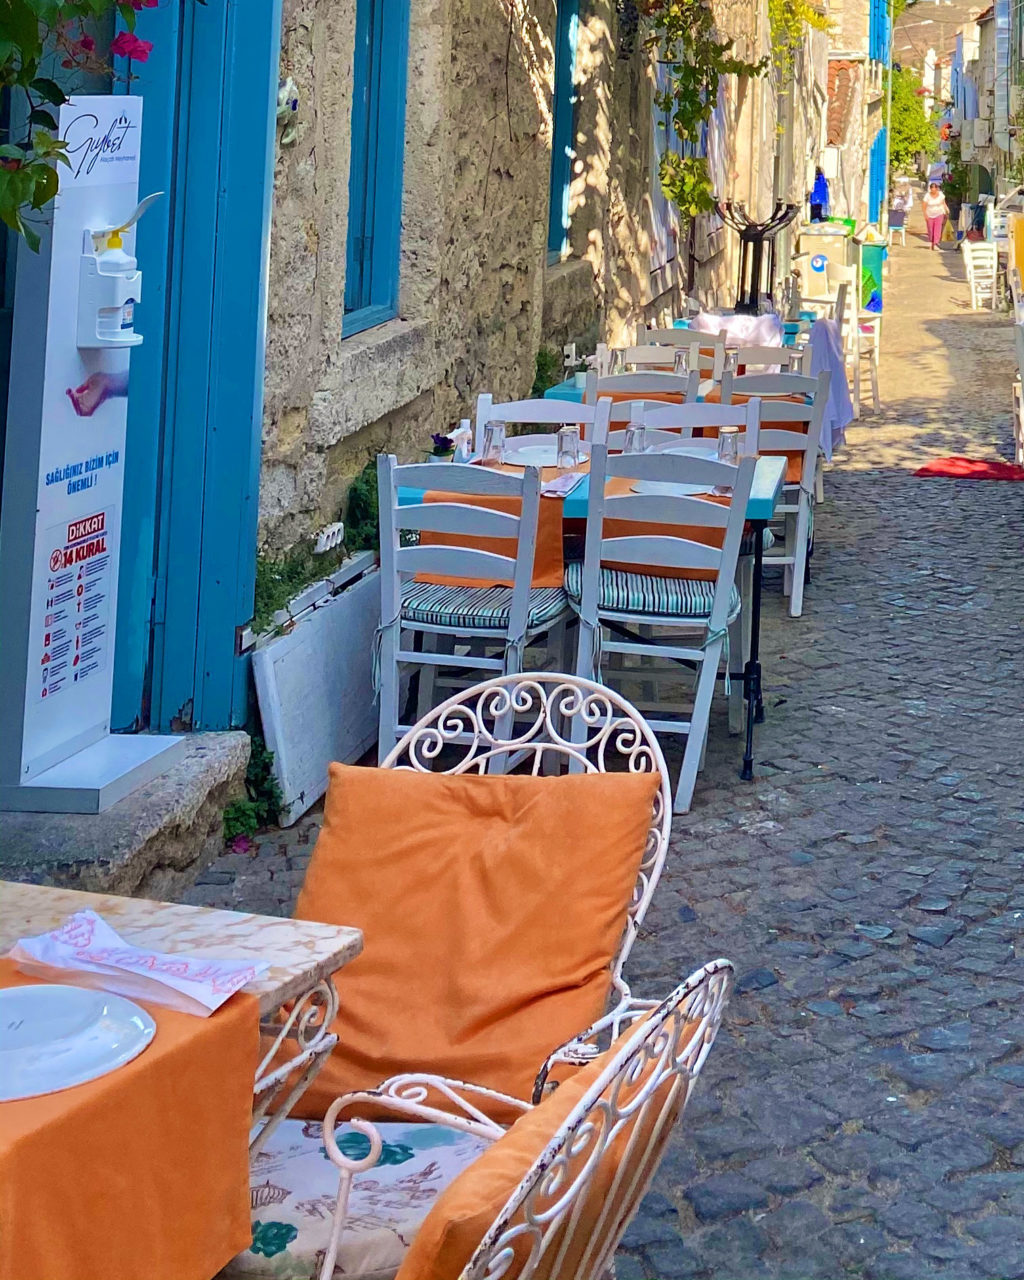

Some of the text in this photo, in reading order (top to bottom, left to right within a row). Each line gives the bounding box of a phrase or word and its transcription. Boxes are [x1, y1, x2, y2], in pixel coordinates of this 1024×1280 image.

[46, 450, 119, 486] SAĞLIĞINIZ BİZİM İÇİN
[67, 473, 93, 495] ÖNEMLİ
[63, 549, 74, 568] 14
[75, 537, 107, 563] KURAL
